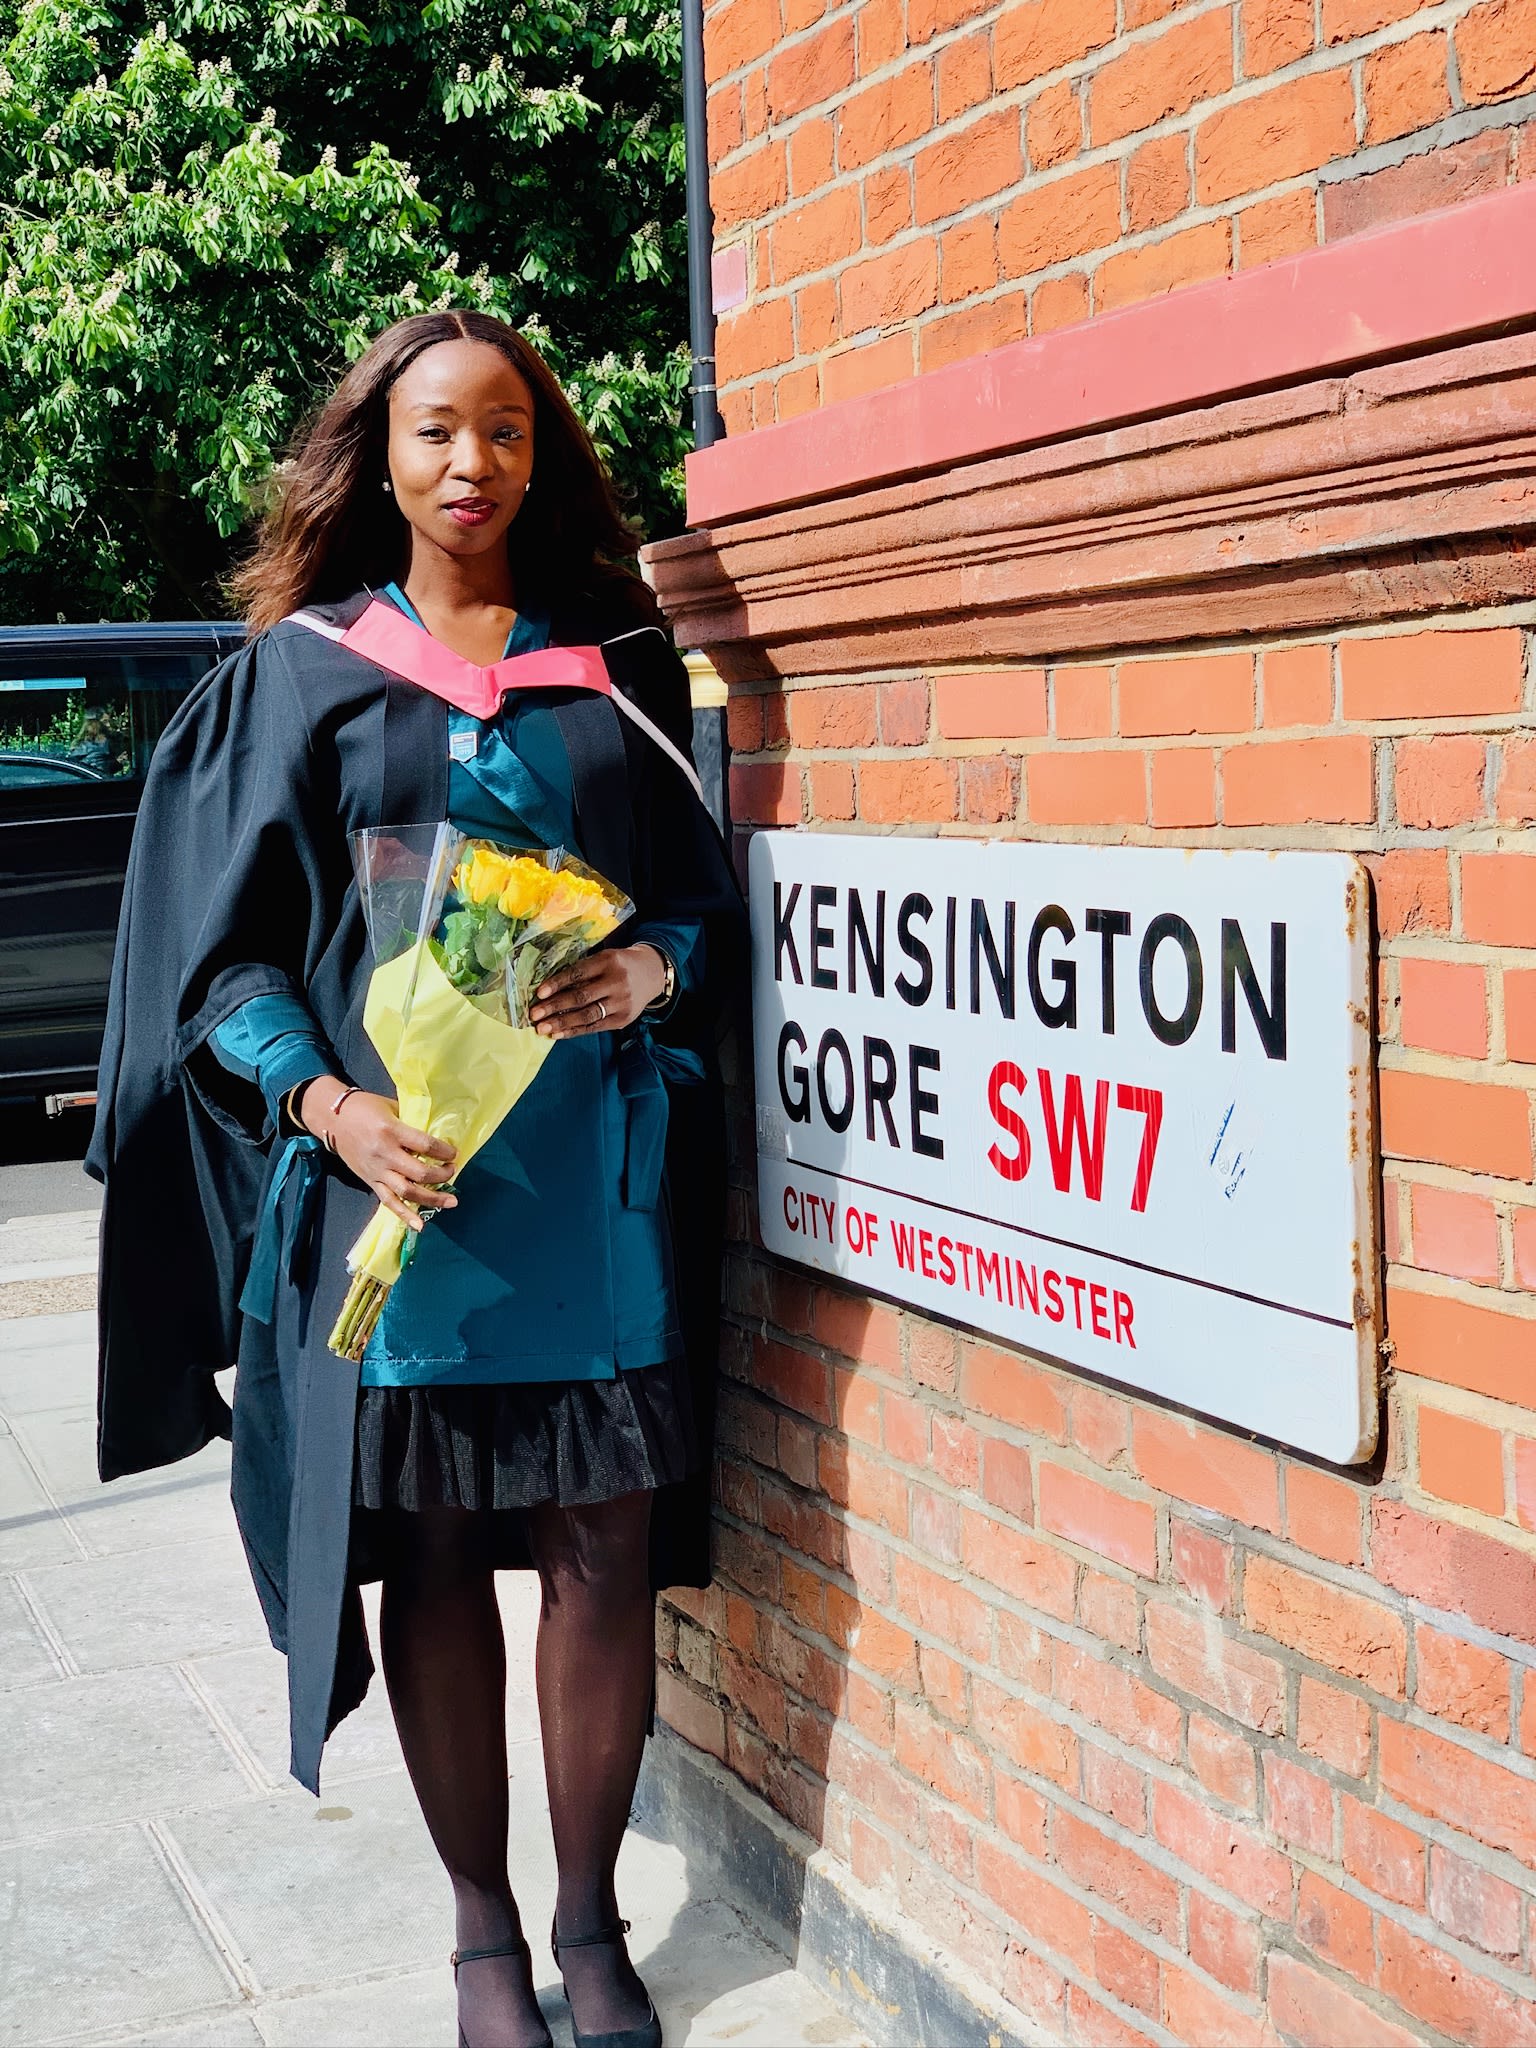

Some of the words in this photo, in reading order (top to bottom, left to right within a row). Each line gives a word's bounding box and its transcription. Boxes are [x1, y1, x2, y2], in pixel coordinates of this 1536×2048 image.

[773, 881, 1287, 1061] KENSINGTON
[777, 1020, 944, 1161] GORE
[987, 1060, 1164, 1213] SW7
[784, 1186, 836, 1245] CITY
[845, 1206, 879, 1257] OF
[890, 1220, 1138, 1350] WESTMINSTER
